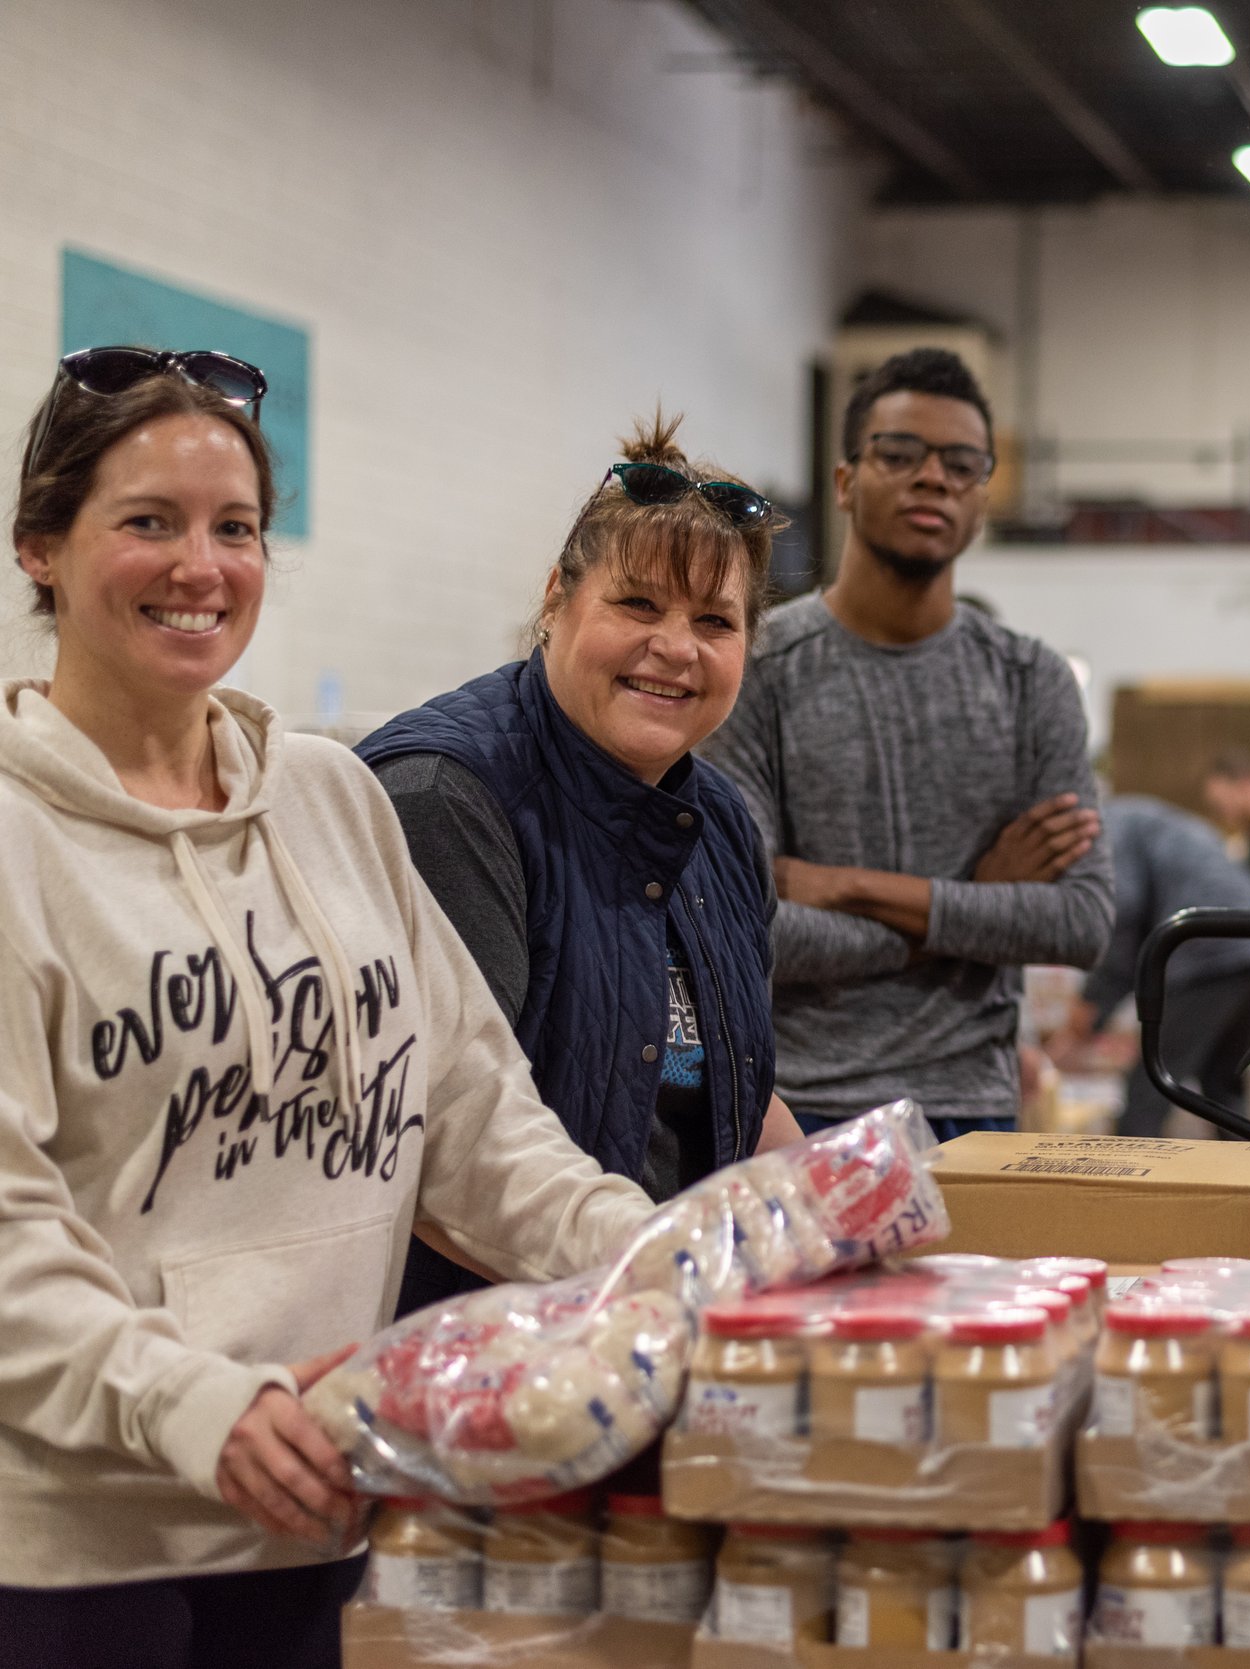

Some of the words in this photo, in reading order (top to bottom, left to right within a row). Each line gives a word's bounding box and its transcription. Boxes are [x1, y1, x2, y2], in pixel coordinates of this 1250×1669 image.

[140, 953, 400, 1214] pesn
[214, 1131, 258, 1181] in
[267, 1085, 340, 1160] the
